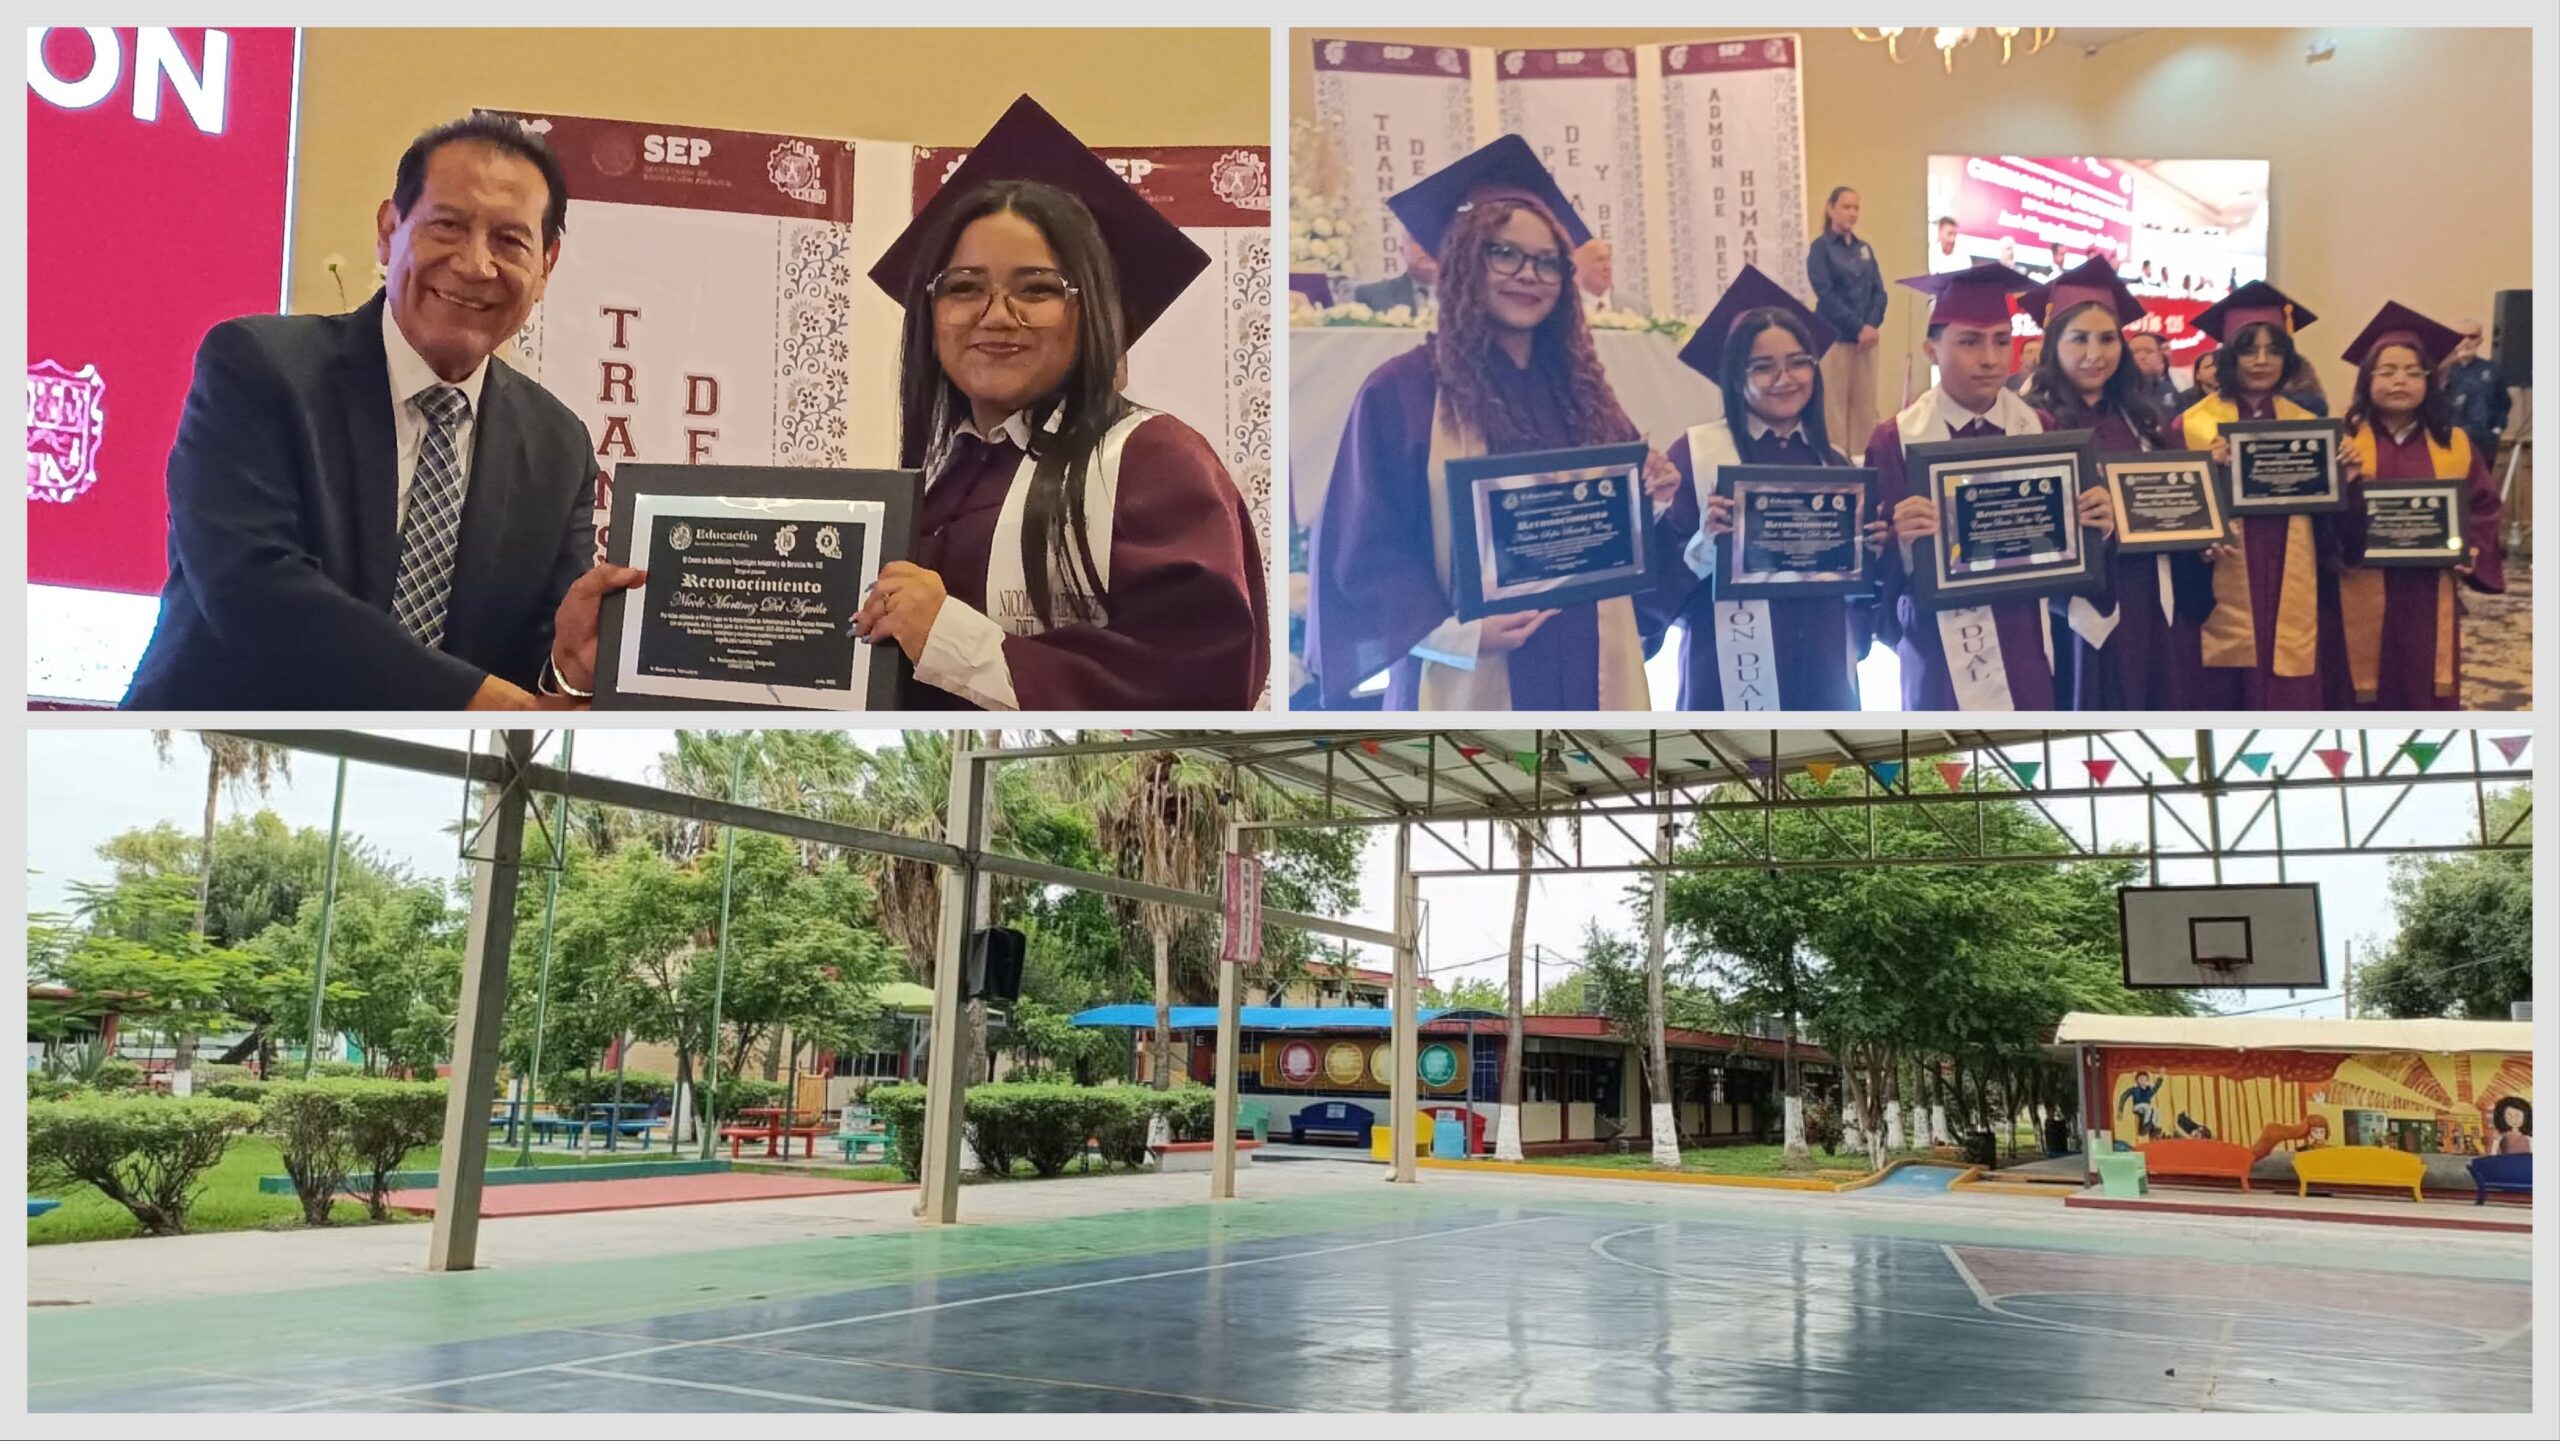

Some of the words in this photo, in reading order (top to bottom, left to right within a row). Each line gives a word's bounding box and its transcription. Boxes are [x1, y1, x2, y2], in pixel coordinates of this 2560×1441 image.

[1708, 87, 1724, 169] ADMON
[643, 134, 713, 166] SEP
[1105, 157, 1153, 184] EP
[695, 528, 758, 542] Educación
[681, 572, 822, 595] Reconocimiento
[1959, 624, 1991, 682] DUAL
